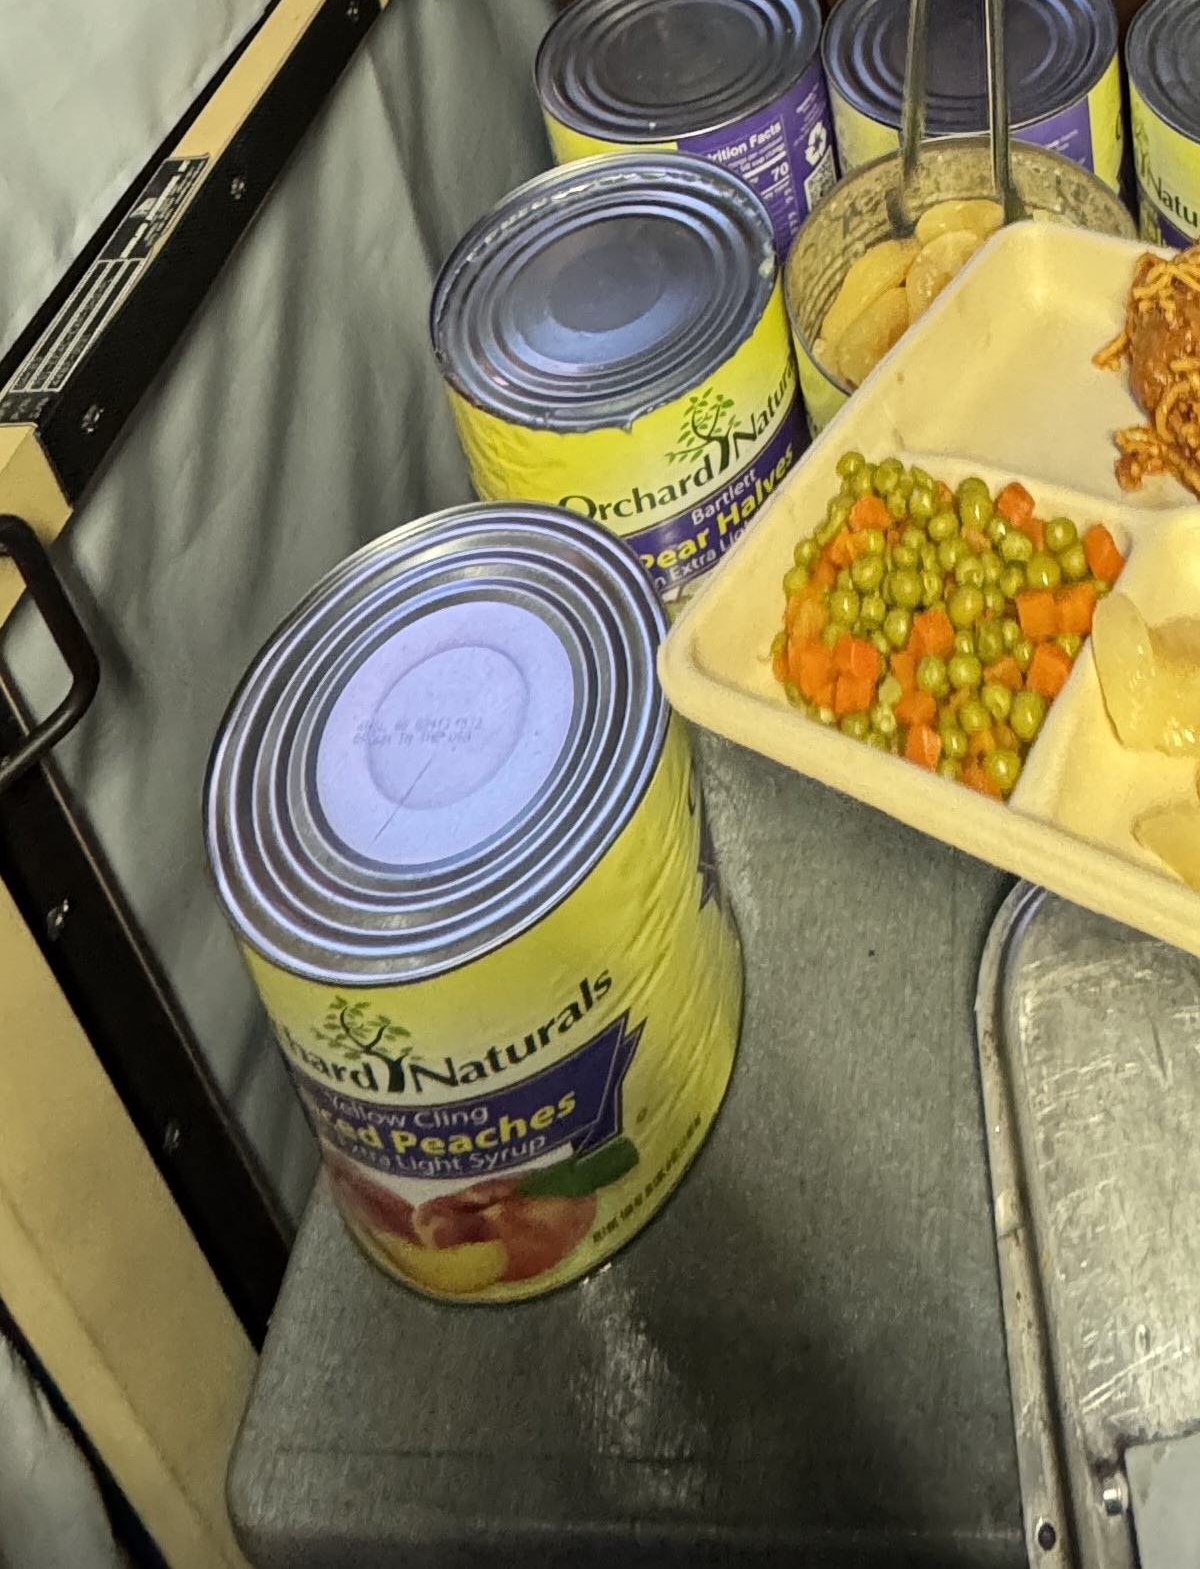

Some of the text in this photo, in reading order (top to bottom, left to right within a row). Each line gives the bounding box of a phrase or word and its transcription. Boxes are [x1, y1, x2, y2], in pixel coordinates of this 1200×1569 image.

[749, 121, 782, 149] Facts
[771, 161, 789, 182] 70
[558, 453, 715, 522] Orchard
[691, 467, 757, 527] Bartlett
[715, 442, 794, 537] Halves
[669, 548, 717, 582] Extra
[408, 968, 614, 1094] Naturals
[390, 1090, 577, 1156] Peaches
[413, 1104, 490, 1128] Cling
[397, 1152, 465, 1177] Light
[469, 1134, 547, 1170] Syrup
